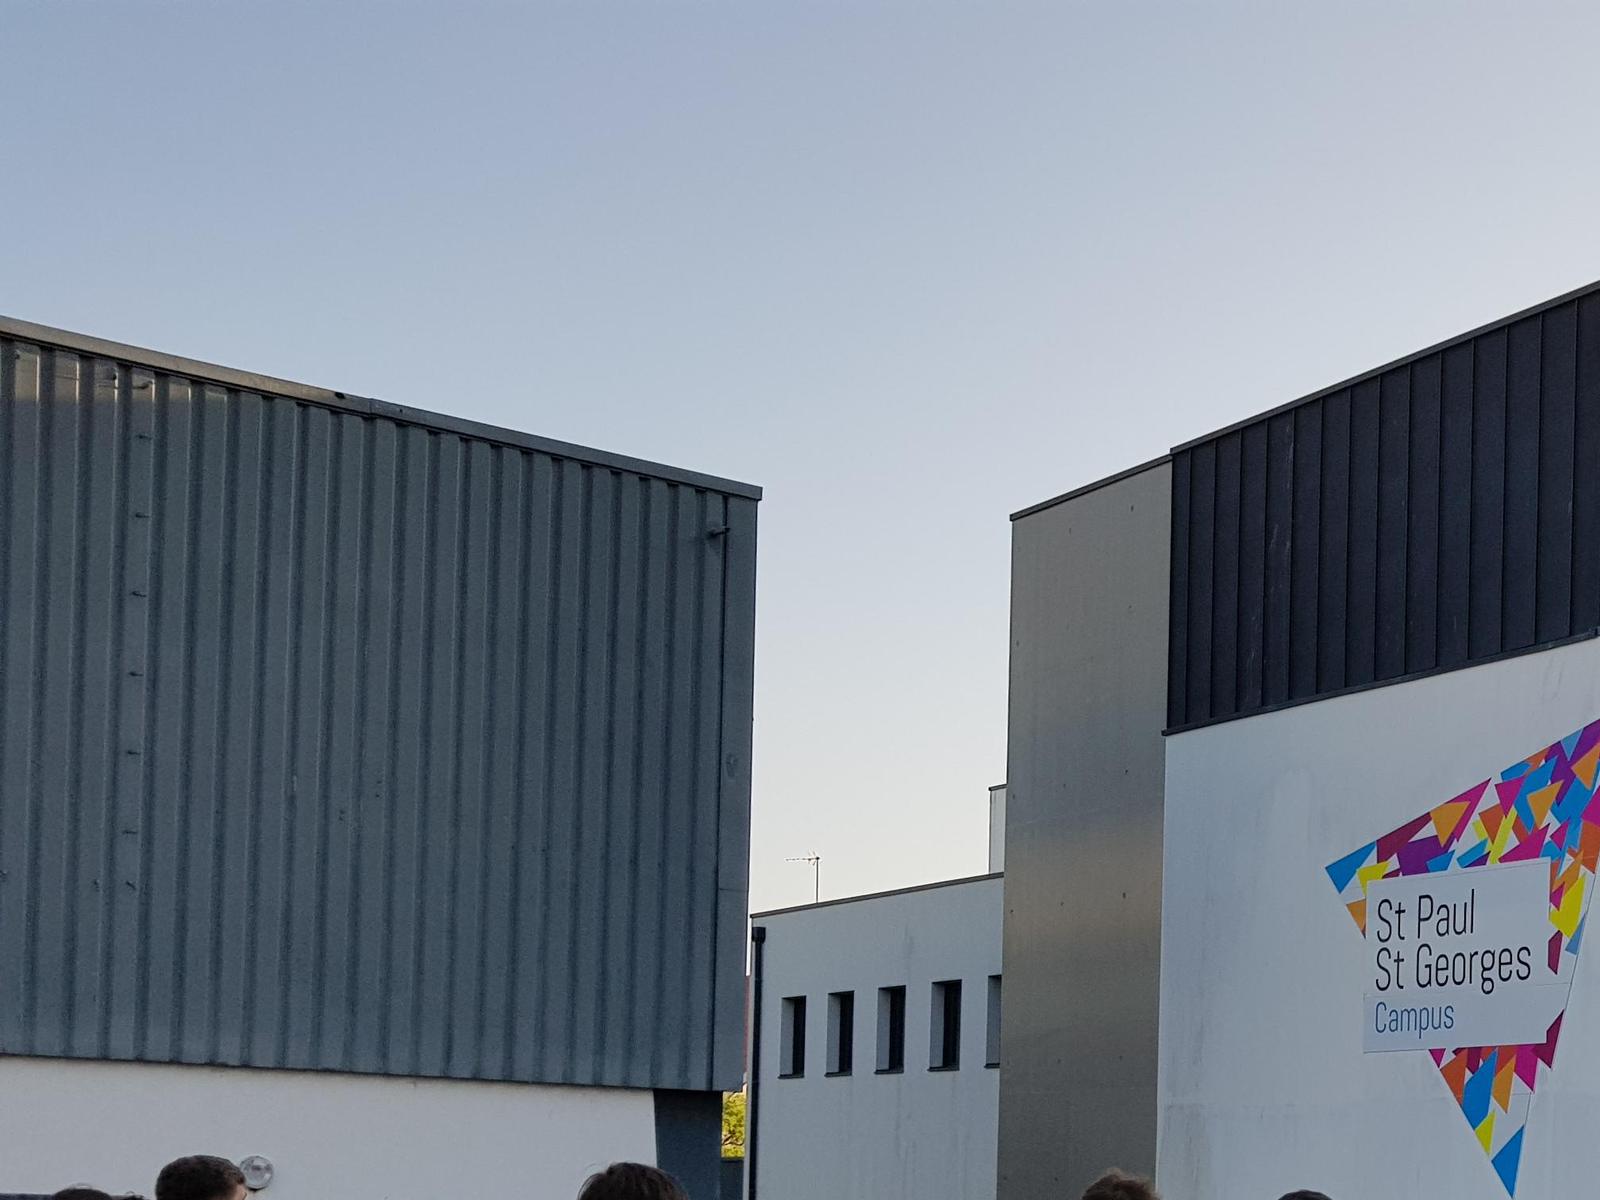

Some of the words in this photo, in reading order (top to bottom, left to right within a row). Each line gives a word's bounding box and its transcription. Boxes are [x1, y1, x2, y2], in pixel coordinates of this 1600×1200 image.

[1376, 898, 1407, 944] St
[1417, 888, 1475, 940] Paul
[1375, 946, 1405, 992] St
[1415, 943, 1532, 996] Georges
[1375, 1001, 1455, 1040] Campus
